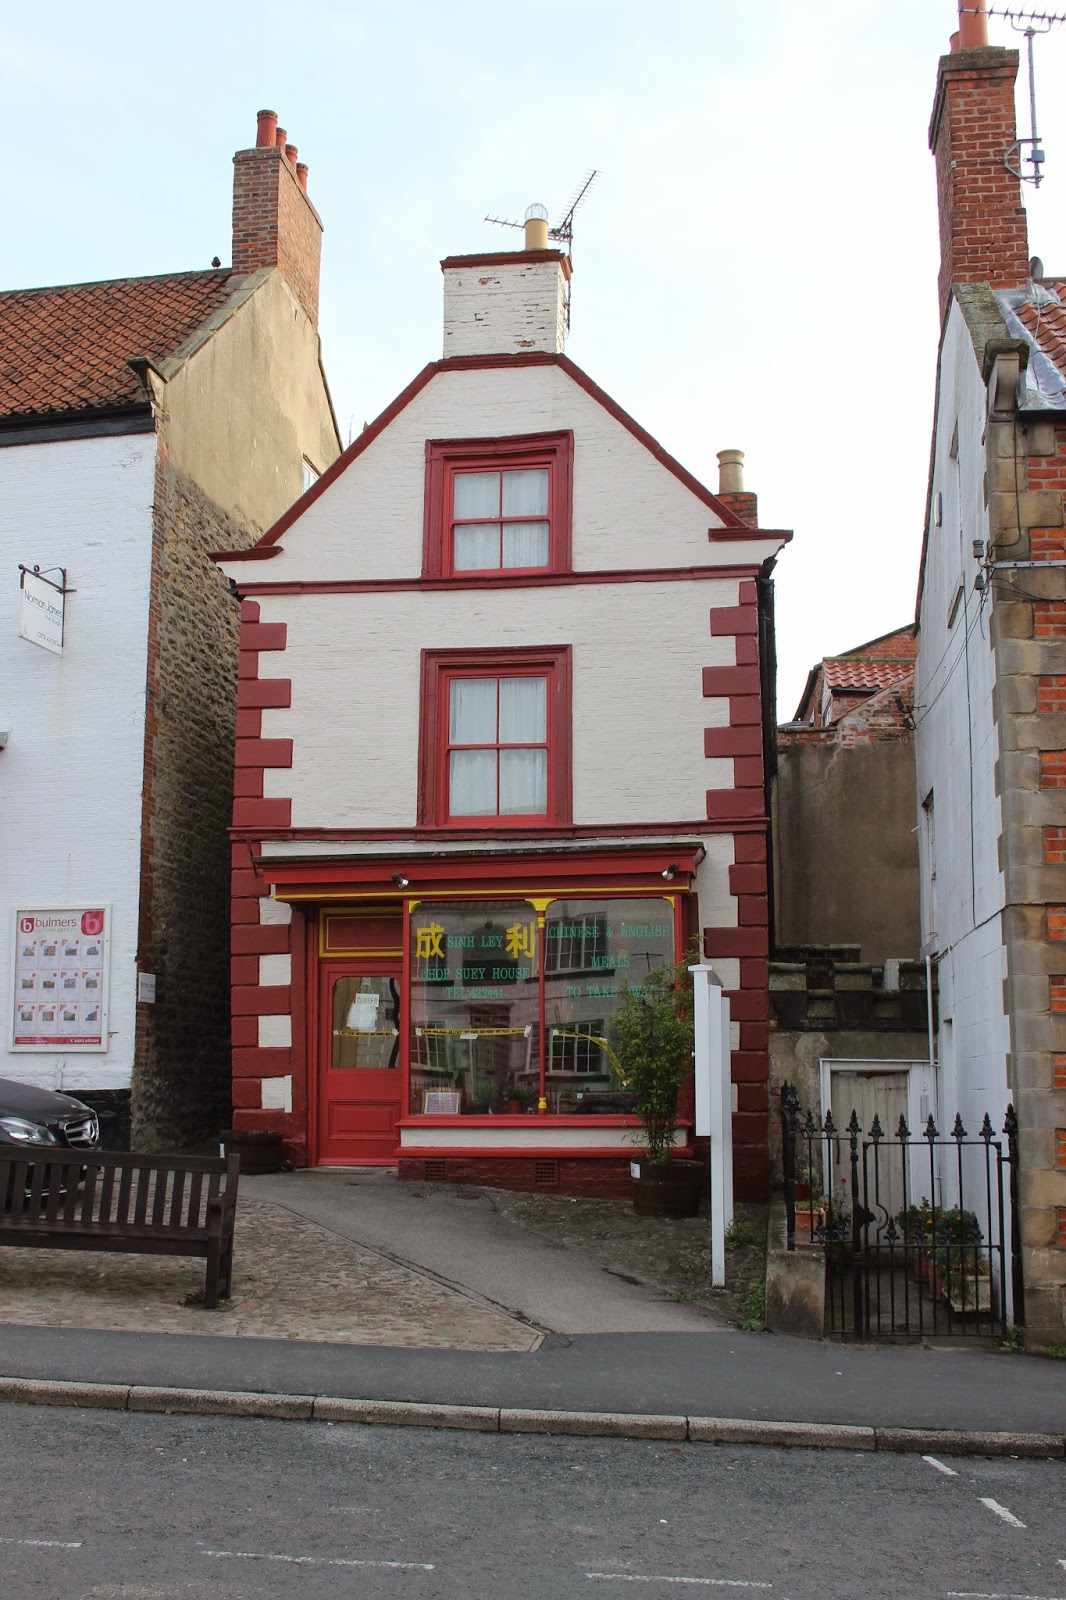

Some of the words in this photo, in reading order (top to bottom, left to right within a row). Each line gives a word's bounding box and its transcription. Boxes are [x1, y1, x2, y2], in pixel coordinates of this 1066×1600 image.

[25, 589, 46, 609] Norman
[46, 601, 62, 618] James
[36, 917, 77, 927] bulmers
[548, 926, 600, 939] CHINESE
[605, 928, 614, 938] &
[620, 924, 671, 938] ENGLISH
[415, 922, 445, 958] 成
[447, 935, 475, 948] SINH
[481, 935, 504, 948] LEY
[505, 922, 535, 958] 利
[590, 955, 631, 968] MEALS
[420, 967, 451, 980] CHOP
[455, 967, 486, 980] SUEY
[491, 967, 530, 980] HOUSE
[566, 986, 581, 999] TO
[586, 985, 618, 998] TAKE
[356, 997, 379, 1005] CLOSED
